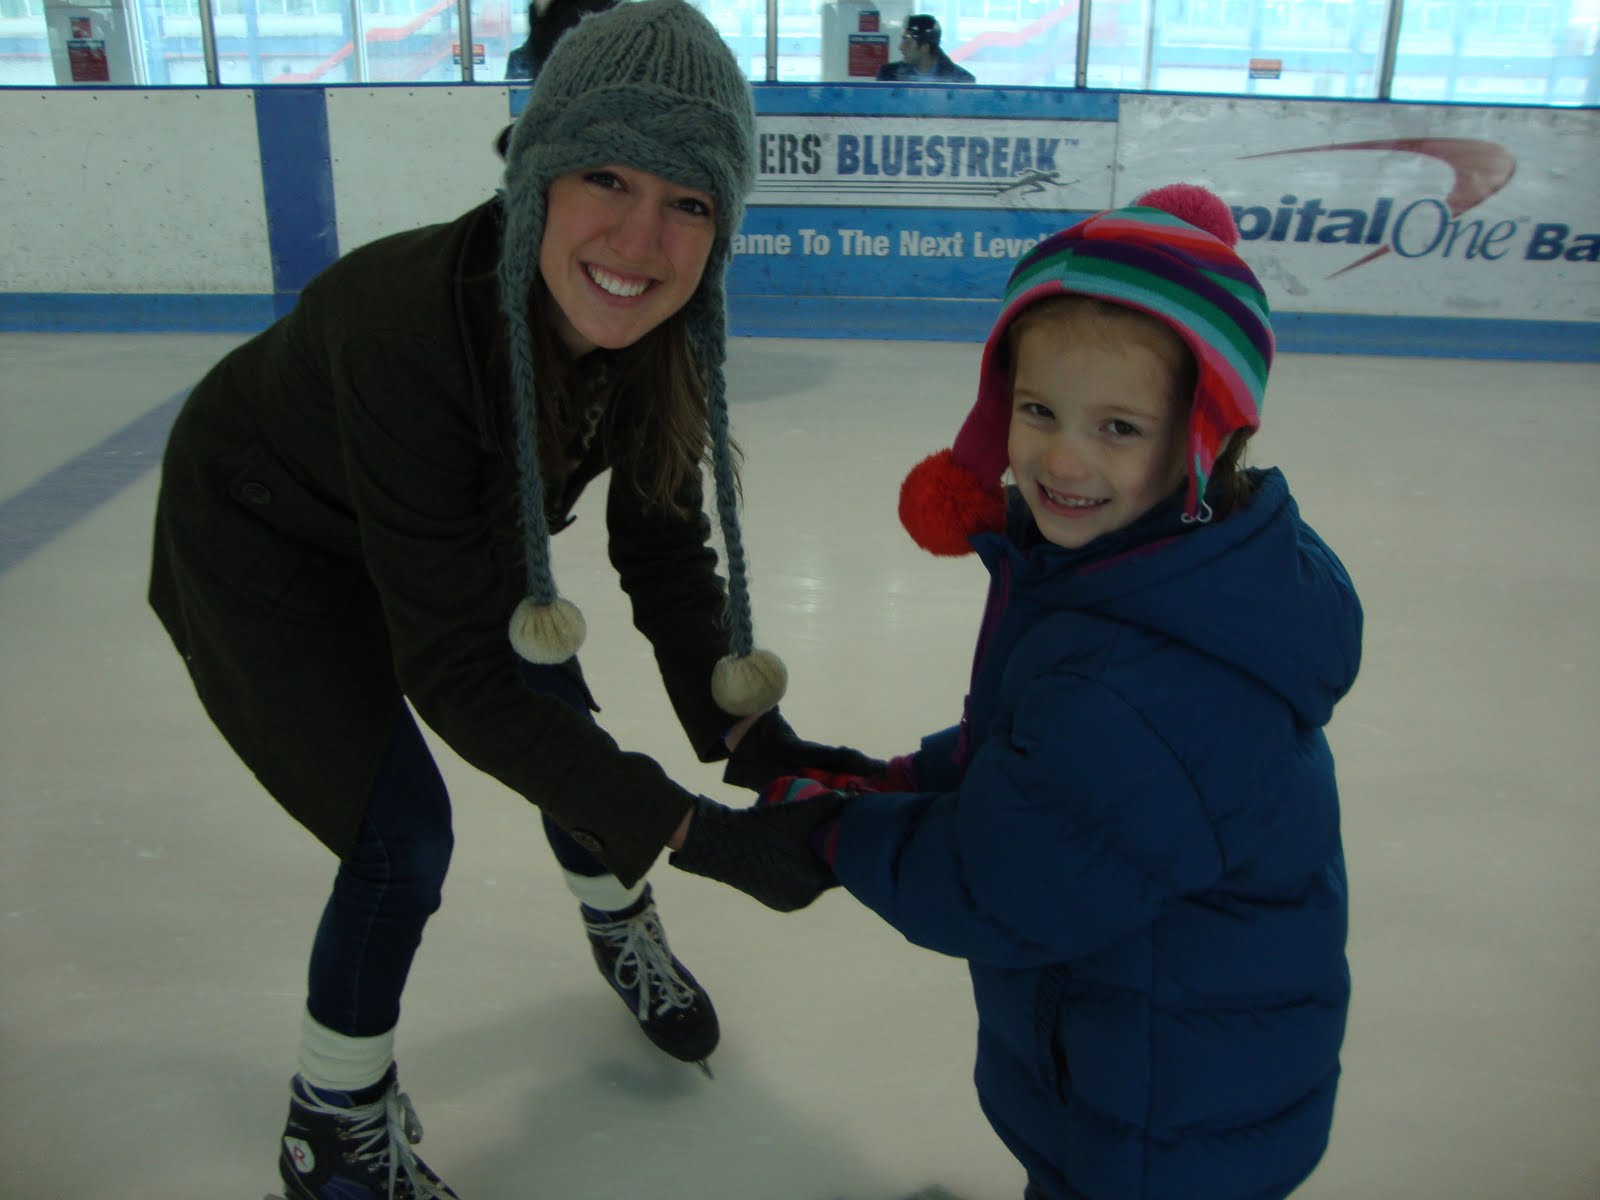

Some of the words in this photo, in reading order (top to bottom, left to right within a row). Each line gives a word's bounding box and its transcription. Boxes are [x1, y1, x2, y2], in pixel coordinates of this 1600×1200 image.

[759, 133, 821, 175] ERS
[837, 134, 1061, 177] BLUESTREAK
[730, 233, 792, 256] ame
[798, 228, 831, 256] To
[838, 229, 890, 256] The
[899, 230, 965, 258] Next
[973, 231, 1049, 259] Leve
[1230, 194, 1518, 261] pitalOne
[1524, 222, 1600, 262] Ba
